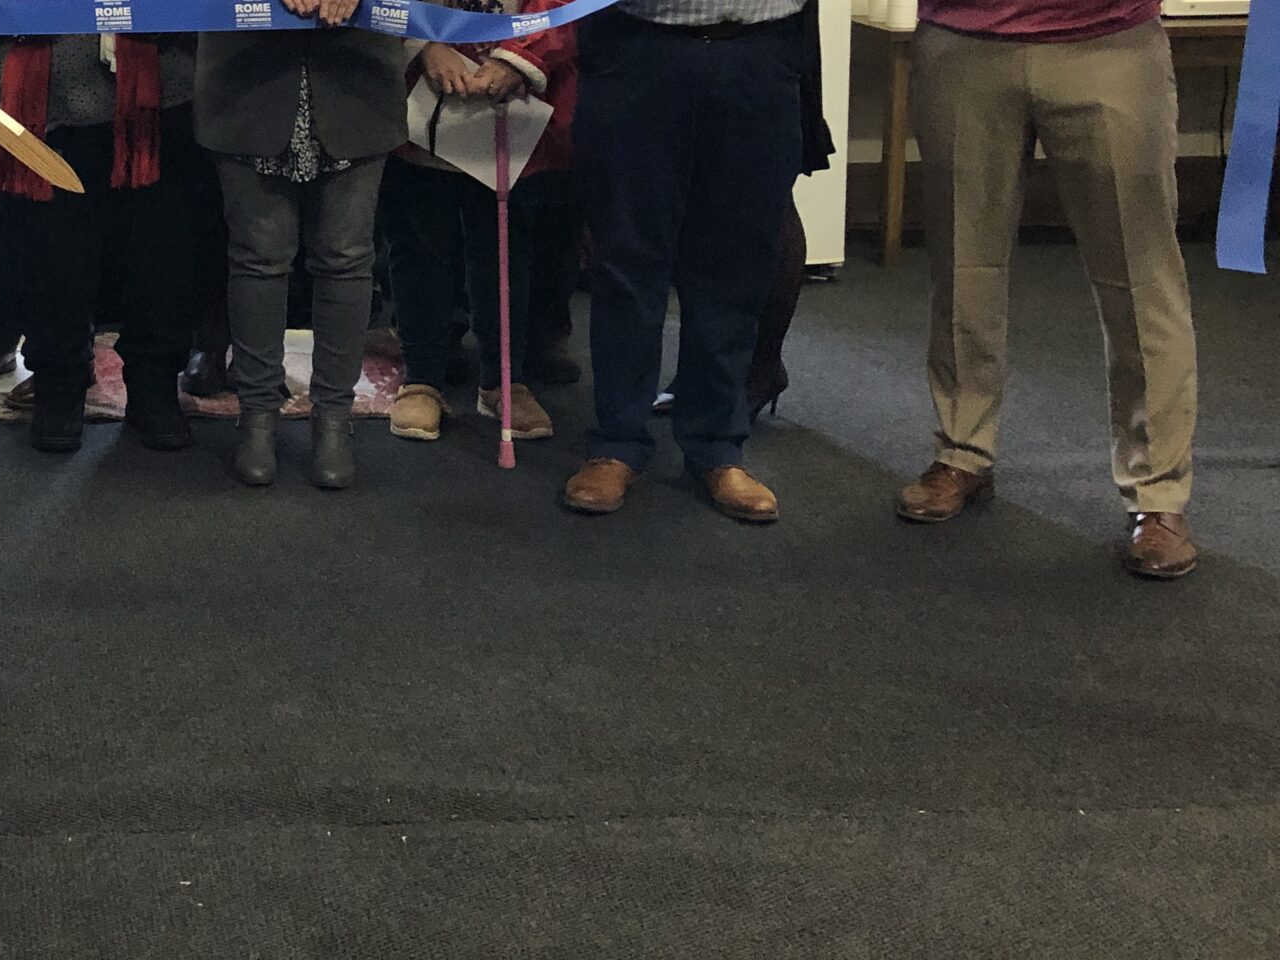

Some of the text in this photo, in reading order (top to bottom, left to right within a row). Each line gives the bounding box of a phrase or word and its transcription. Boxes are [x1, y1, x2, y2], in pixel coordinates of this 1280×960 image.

[95, 7, 131, 17] ROME
[235, 3, 271, 13] ROME
[371, 6, 409, 20] ROME
[512, 16, 550, 28] ROME
